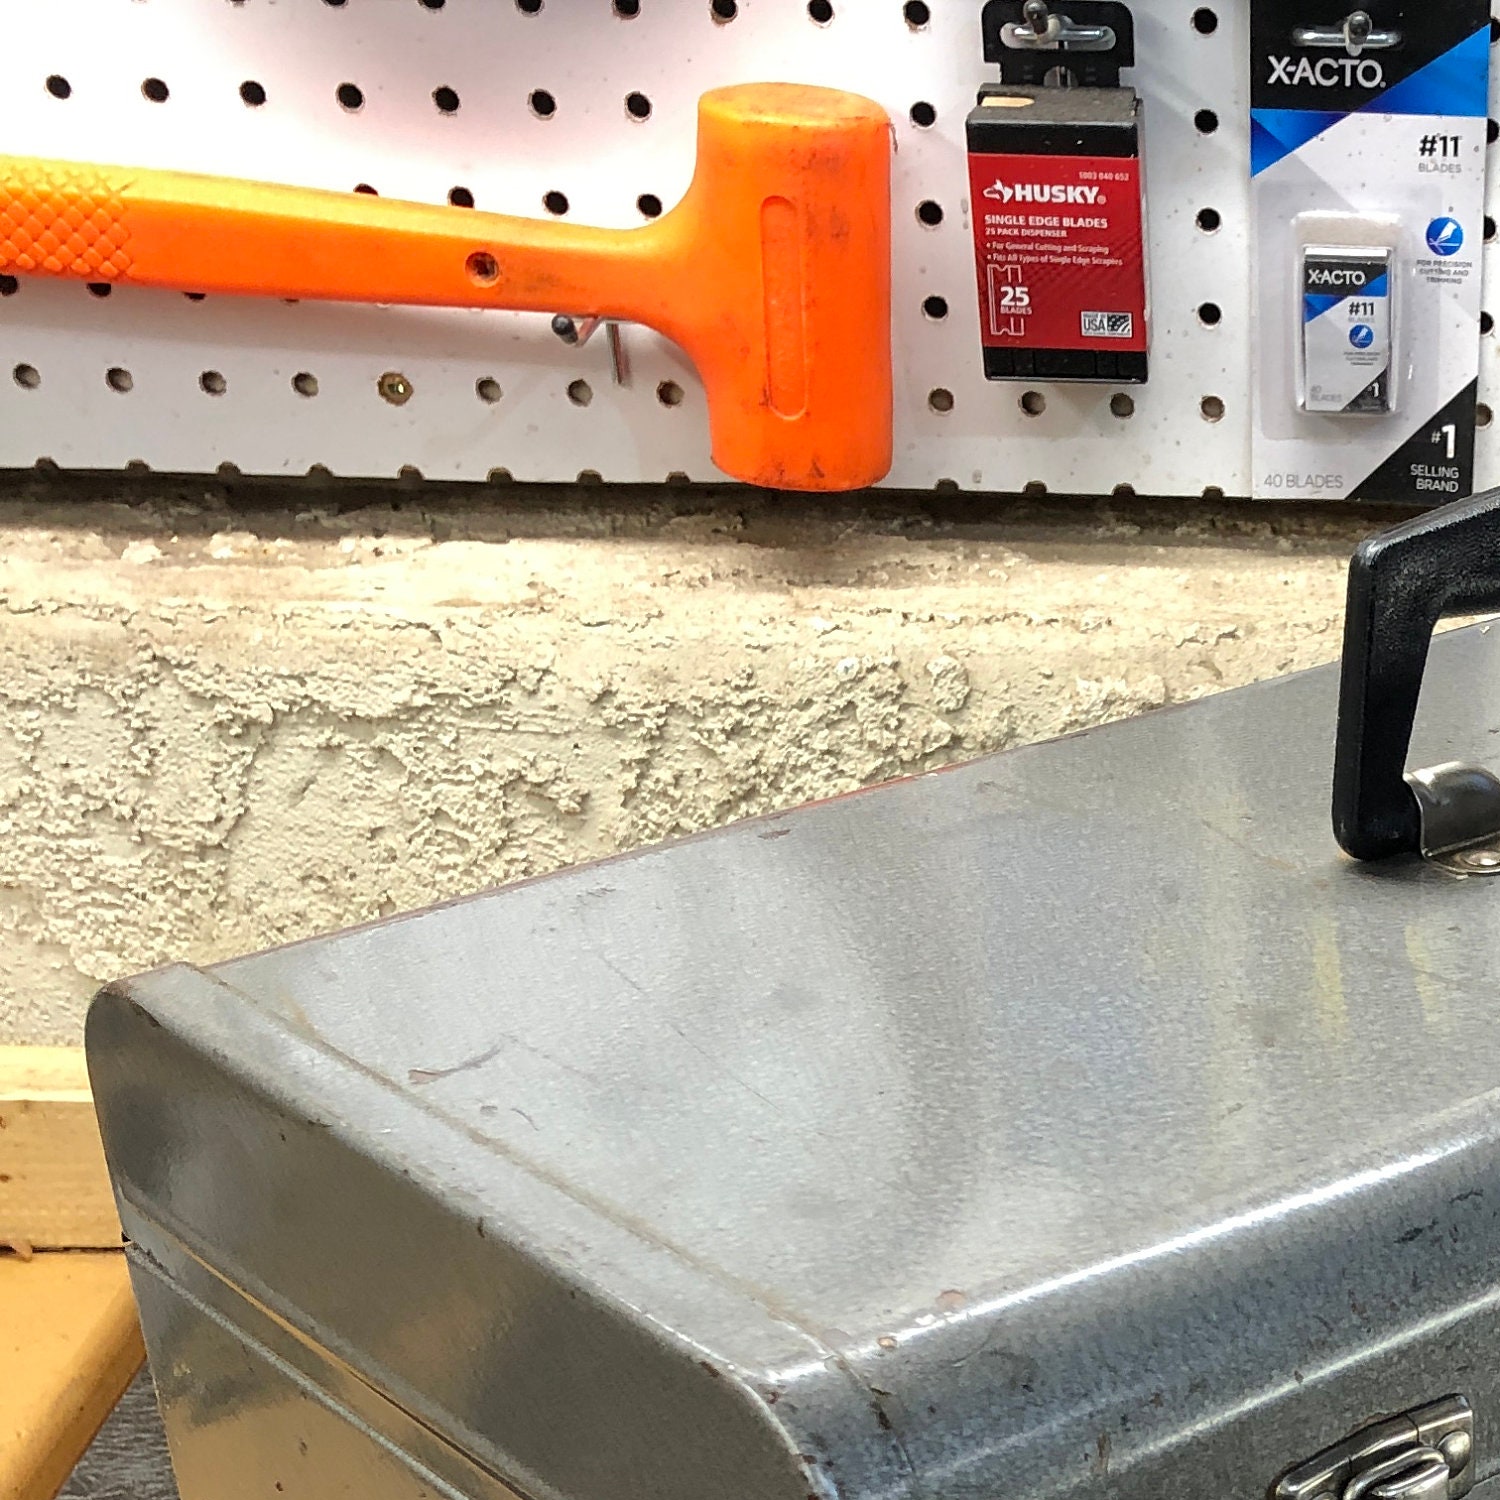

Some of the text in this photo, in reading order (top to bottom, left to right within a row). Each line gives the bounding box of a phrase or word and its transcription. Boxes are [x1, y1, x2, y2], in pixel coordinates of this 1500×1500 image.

[1268, 55, 1383, 88] X-ACTO
[1418, 134, 1460, 157] #11
[1418, 163, 1462, 174] BLADES
[1014, 183, 1099, 204] HUSKY
[984, 214, 1108, 229] SINGLE EDGE BLADES
[985, 227, 1068, 238] 25 PACK DISPENSER
[1005, 241, 1034, 251] General
[1035, 243, 1062, 254] Cutting
[1063, 244, 1077, 253] and
[1078, 244, 1110, 256] Scraping
[1308, 269, 1365, 286] X-ACTO
[1000, 286, 1030, 306] 25
[1000, 306, 1032, 315] BLADES
[1349, 302, 1375, 316] #11
[1083, 318, 1106, 331] USA
[1431, 424, 1456, 459] #1
[1410, 463, 1460, 479] SELLING
[1264, 474, 1343, 489] 40 BLADES
[1415, 480, 1459, 493] BRAND
